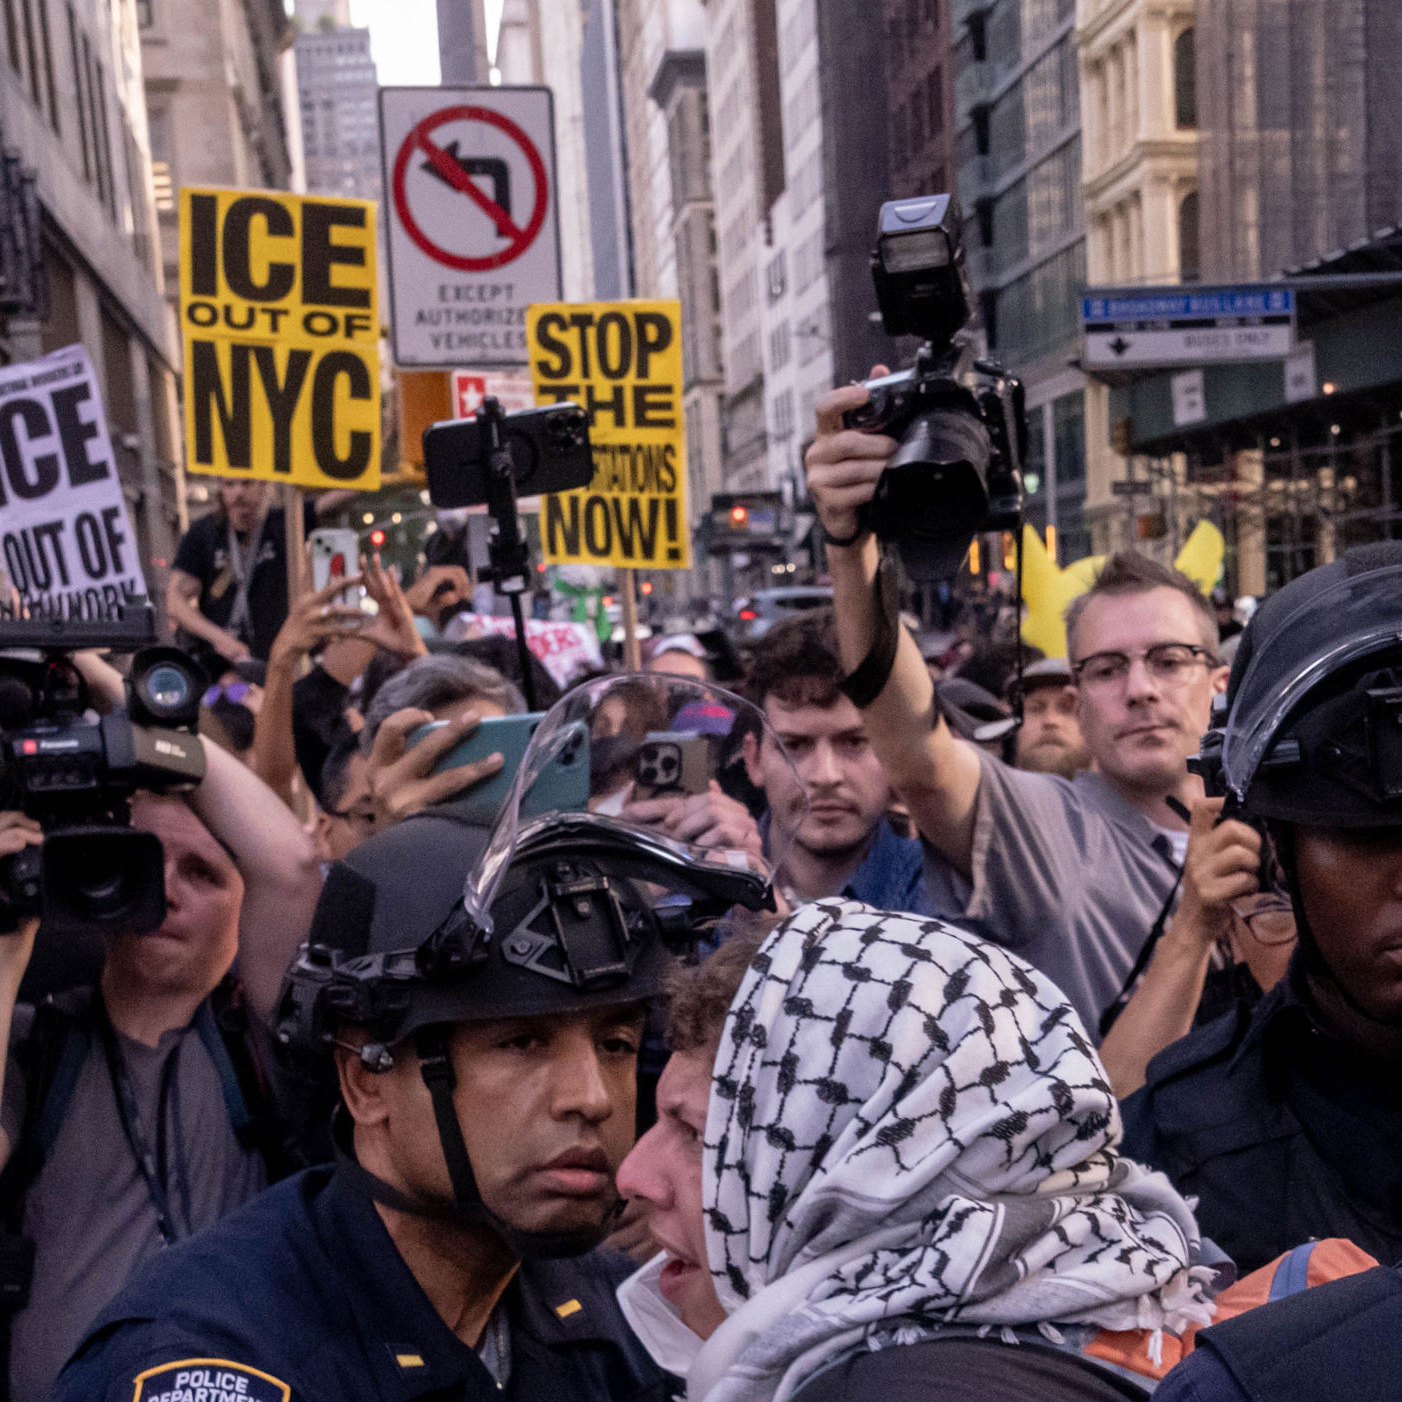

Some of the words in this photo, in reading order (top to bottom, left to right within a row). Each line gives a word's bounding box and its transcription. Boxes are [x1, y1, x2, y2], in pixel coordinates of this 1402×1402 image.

[191, 193, 373, 309] ICE
[187, 302, 290, 334] OUT
[302, 311, 372, 339] OF
[415, 307, 527, 326] AUTHORIZE
[438, 283, 514, 303] EXCEPT
[535, 311, 673, 380] STOP
[192, 340, 373, 481] NYC
[538, 383, 676, 429] THE
[2, 519, 72, 593] OUT
[75, 506, 126, 580] OF
[544, 495, 681, 562] NOW!
[175, 1370, 249, 1394] POLICE
